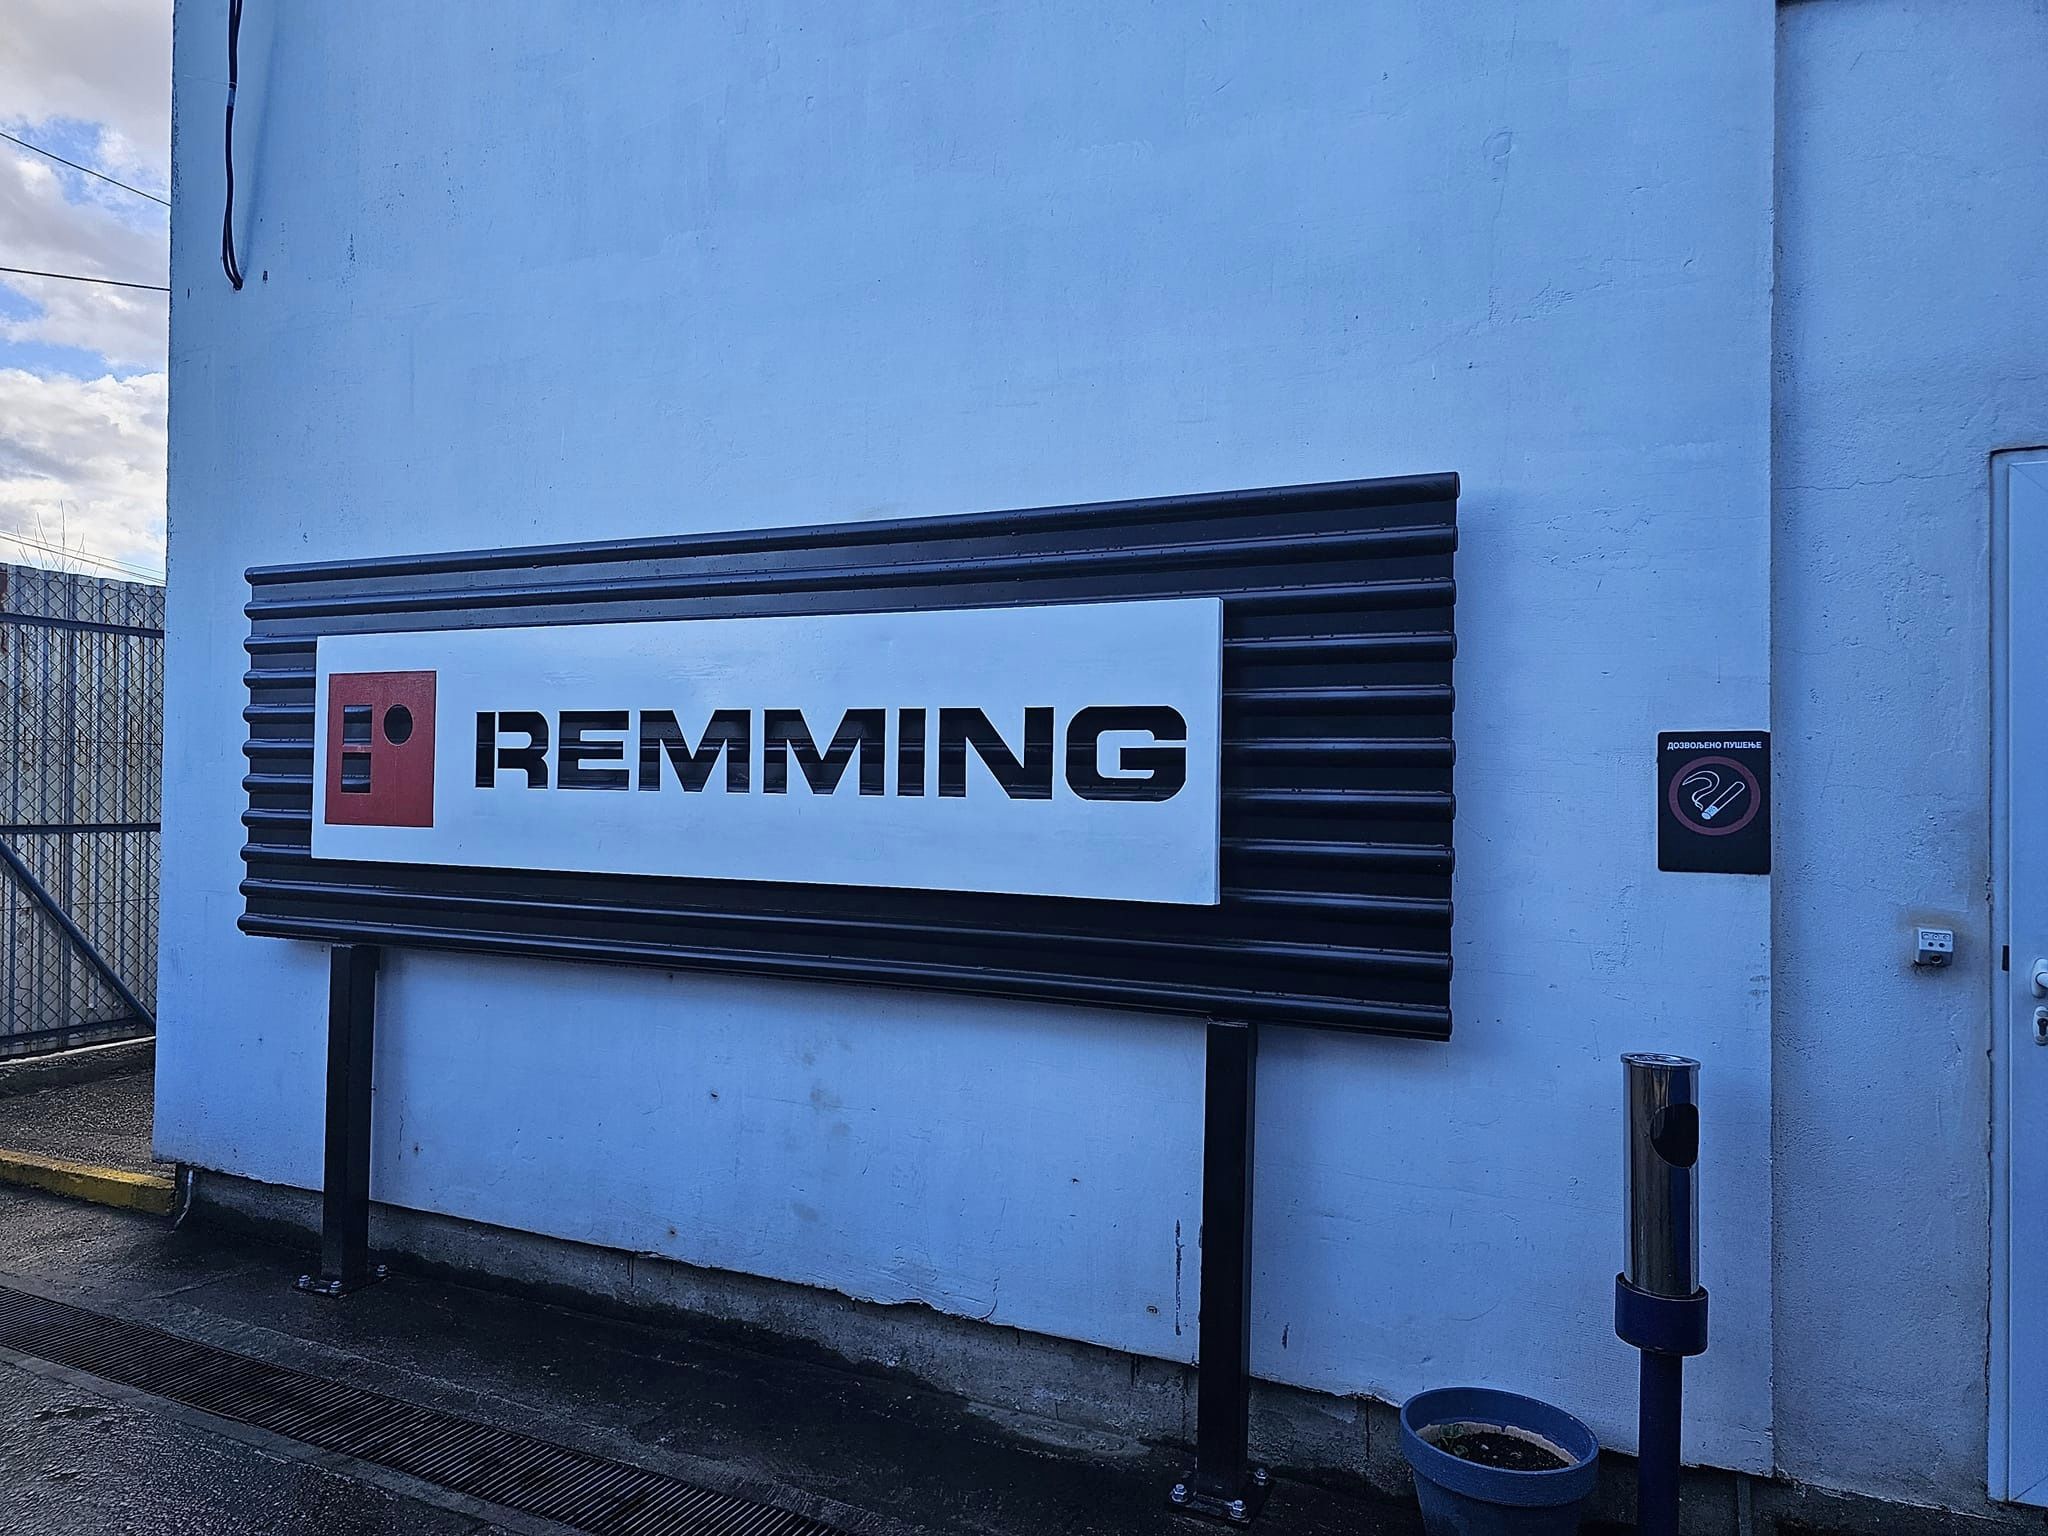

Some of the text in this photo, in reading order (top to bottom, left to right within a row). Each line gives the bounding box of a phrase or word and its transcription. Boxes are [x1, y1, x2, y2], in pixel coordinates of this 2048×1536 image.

[475, 705, 1187, 802] REMMING
[1667, 741, 1762, 750] ДОЗВОЉЕНО ПУШЕЊЕ
